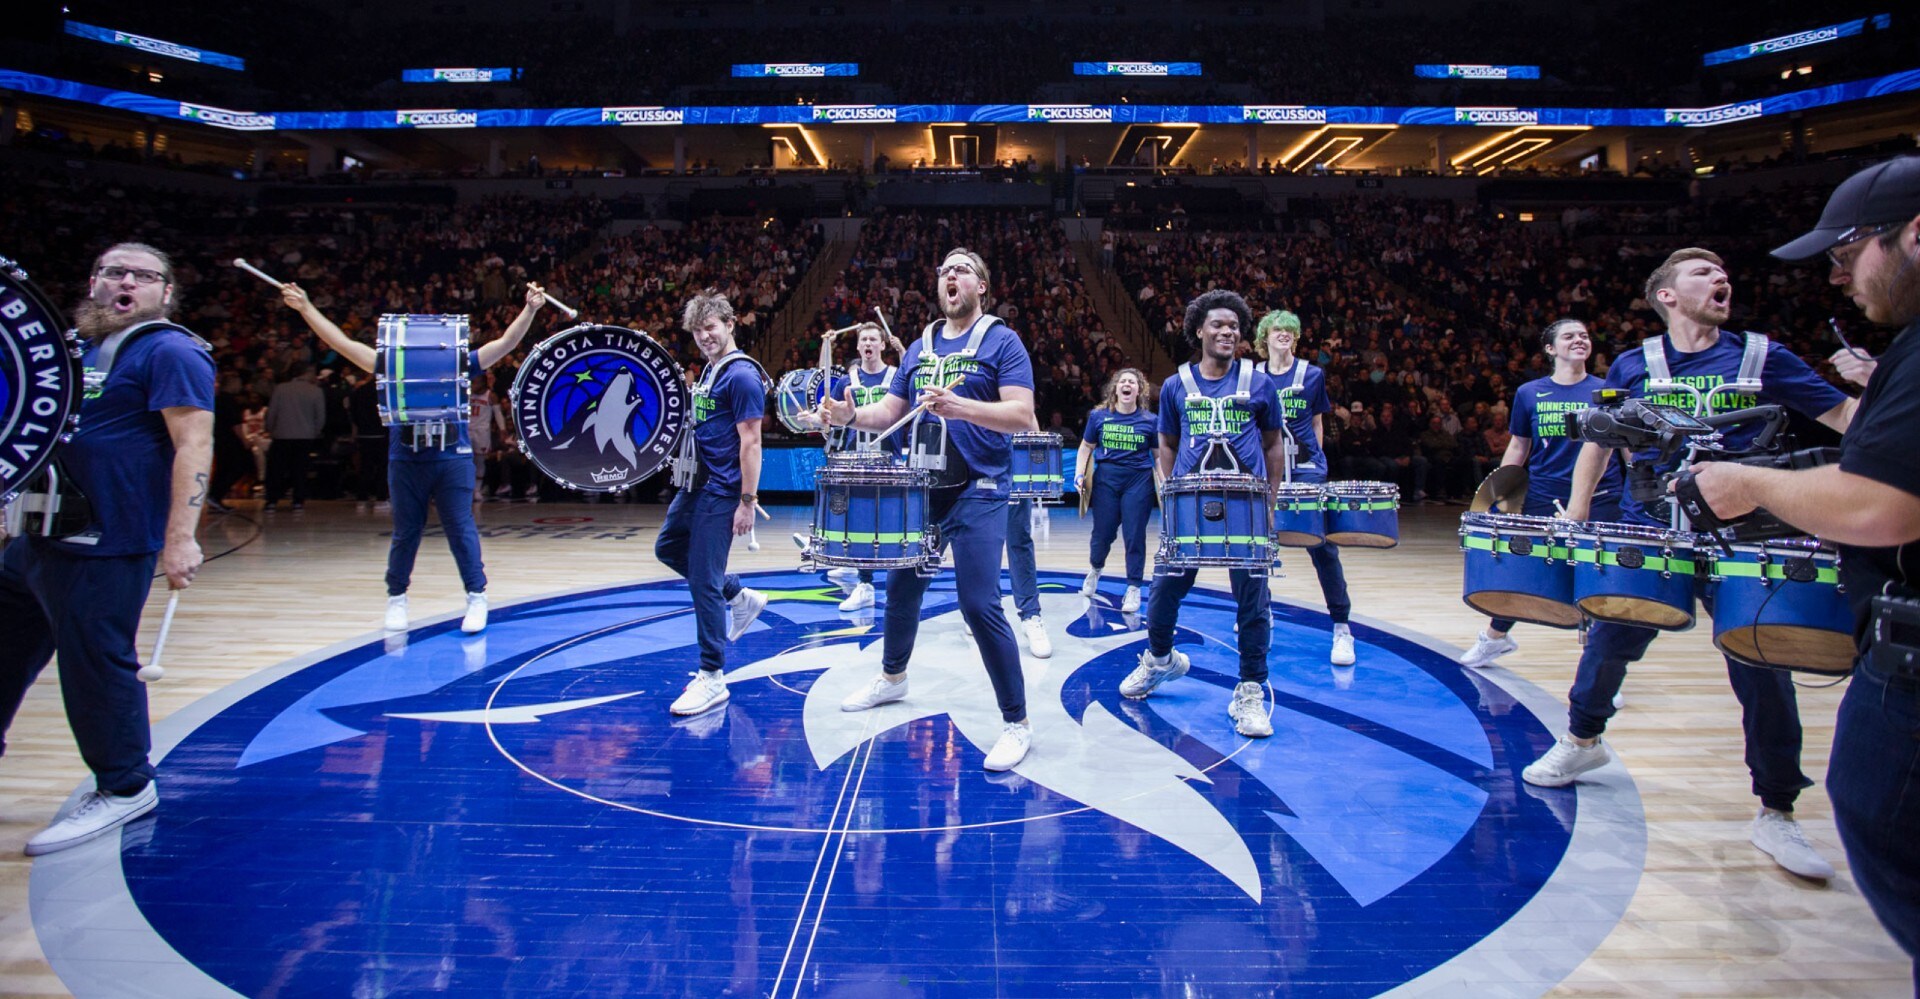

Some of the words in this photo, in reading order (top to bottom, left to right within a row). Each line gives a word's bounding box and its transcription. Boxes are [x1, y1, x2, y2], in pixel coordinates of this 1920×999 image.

[1749, 27, 1838, 54] PACKCUSSION
[764, 66, 825, 75] PACKCUSSION
[1107, 64, 1168, 73] PACKCUSSION
[1448, 67, 1507, 76] PACKCUSSION
[180, 103, 276, 127] PACKCUSSION
[602, 110, 684, 122] PACKCUSSION
[813, 108, 896, 119] PACKCUSSION
[1028, 108, 1112, 119] PACKCUSSION
[1243, 108, 1326, 120] PACKCUSSION
[1455, 110, 1538, 122] PACKCUSSION
[1664, 102, 1762, 123] PACKCUSSION
[397, 113, 477, 125] PACKCUSSION
[0, 287, 61, 480] BERWOLVE
[523, 336, 594, 439] MINNESOTA
[604, 333, 680, 455] TIMBERWOLVES
[1536, 401, 1589, 413] MINNESOTA
[1186, 410, 1250, 422] TIMBEOLVES
